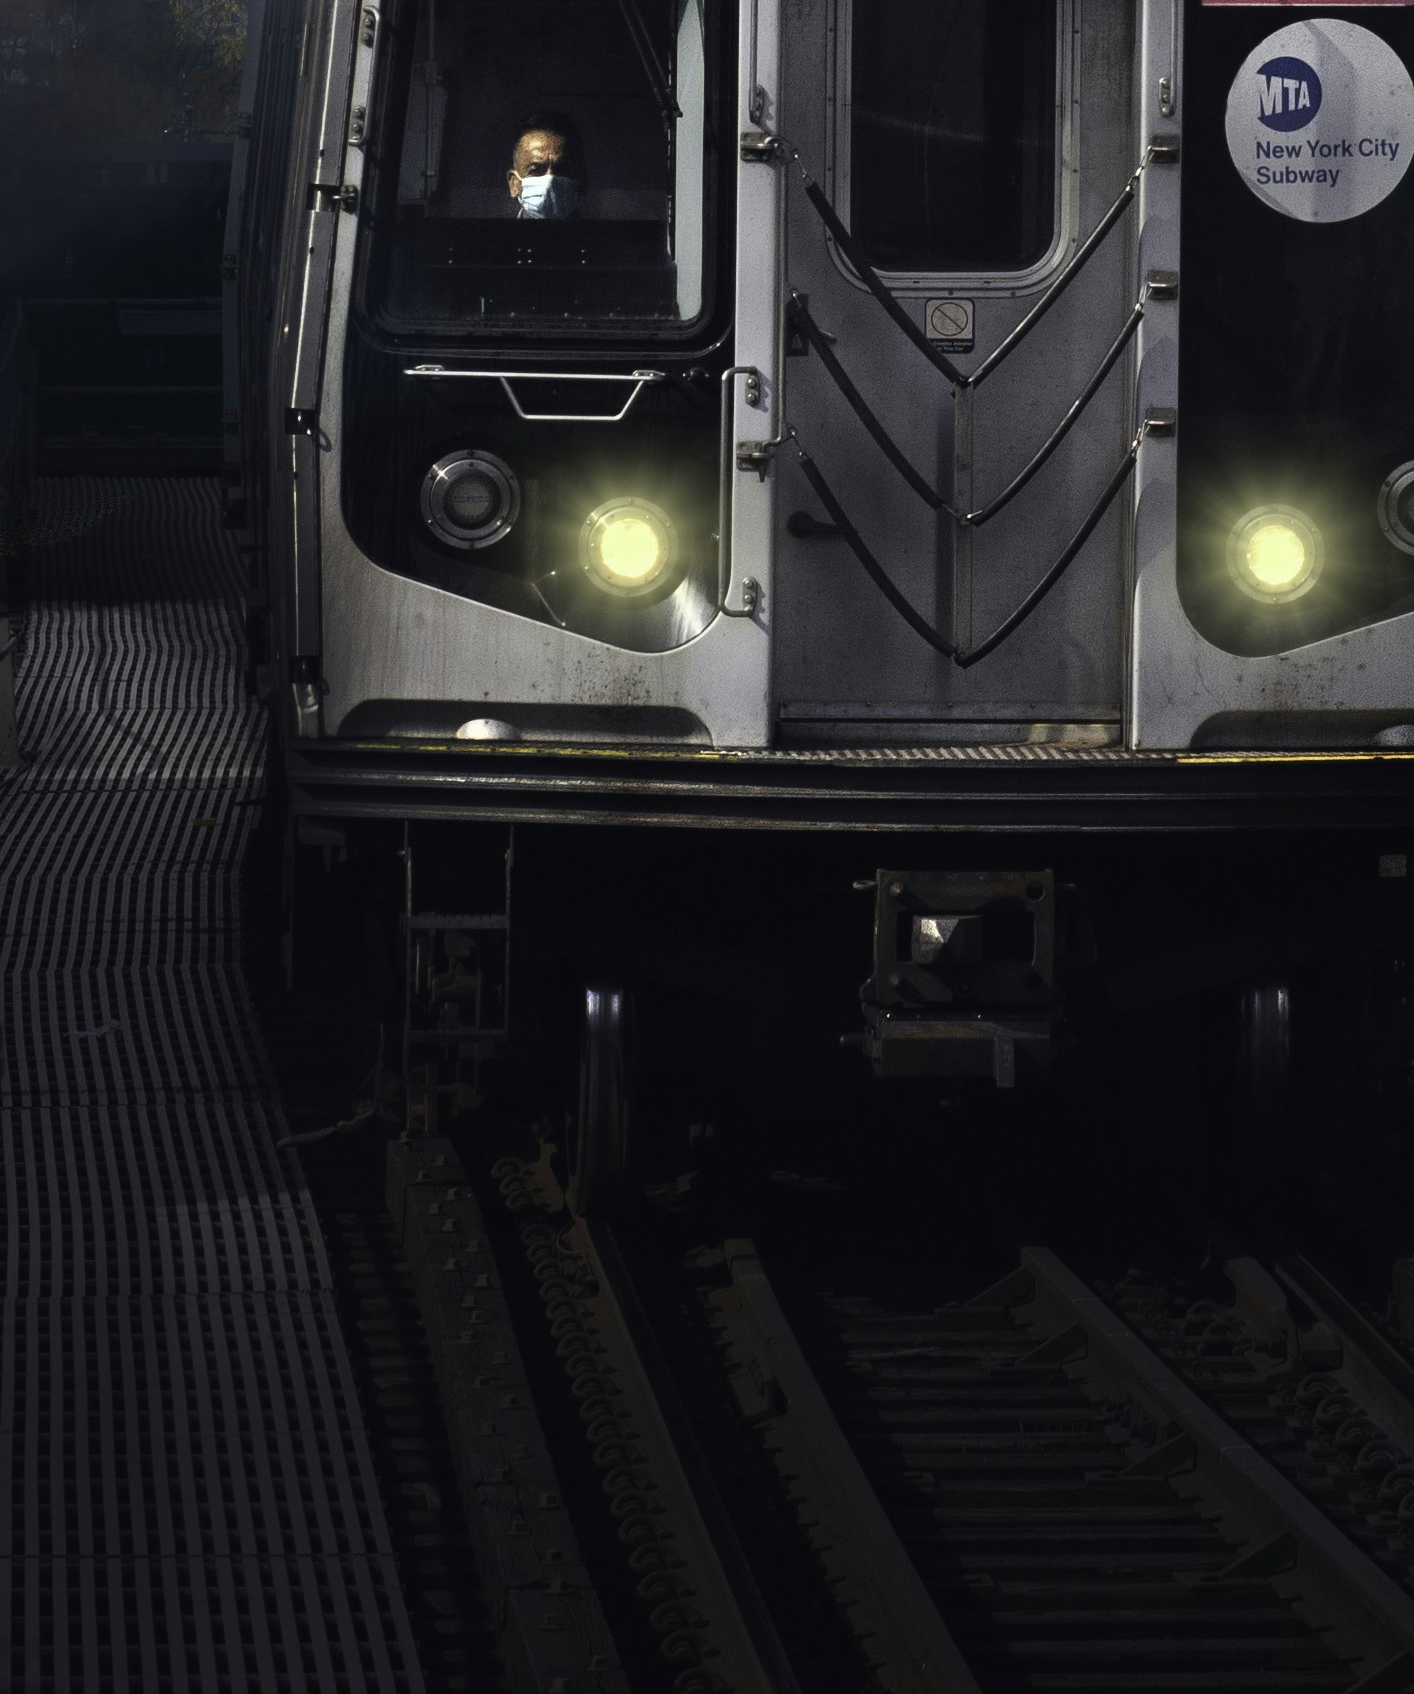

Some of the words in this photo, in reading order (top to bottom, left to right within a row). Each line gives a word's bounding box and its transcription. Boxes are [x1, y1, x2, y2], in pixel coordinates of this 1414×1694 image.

[1257, 74, 1311, 117] MTA
[1255, 140, 1302, 159] New
[1305, 139, 1353, 159] York
[1358, 138, 1400, 161] City
[1256, 166, 1341, 187] Subway
